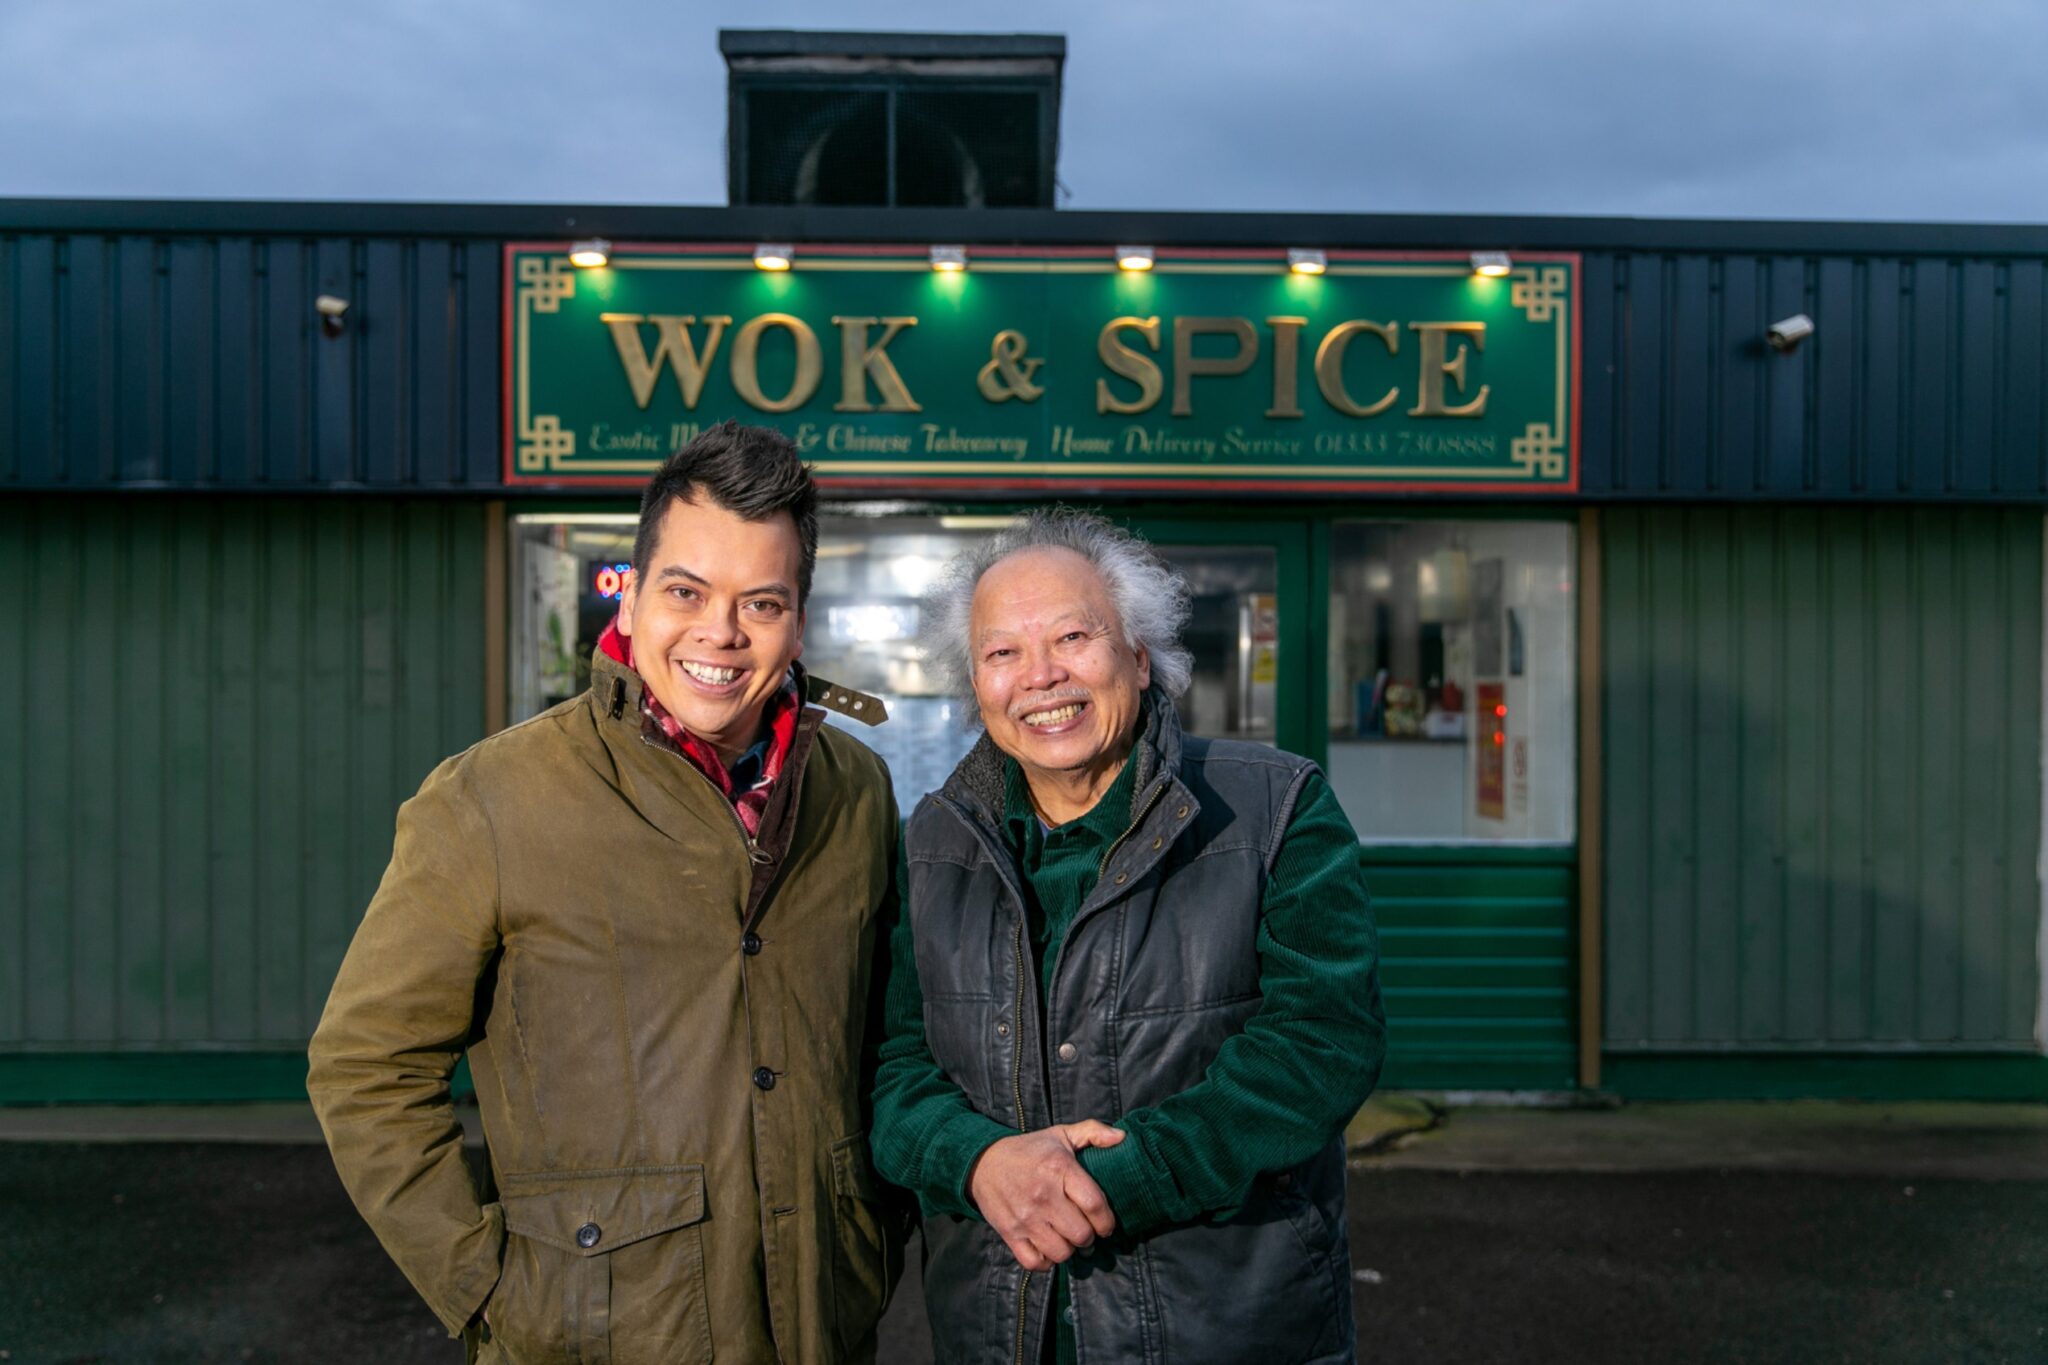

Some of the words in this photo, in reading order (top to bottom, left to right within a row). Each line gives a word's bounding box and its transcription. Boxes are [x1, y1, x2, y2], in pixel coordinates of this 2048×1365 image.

[600, 313, 920, 413] WOK
[977, 328, 1046, 403] &
[1095, 315, 1491, 419] SPICE
[589, 422, 660, 452] Exotic
[797, 423, 821, 452] &
[827, 425, 912, 455] Chinese
[921, 424, 1028, 462] Takeaway
[1051, 426, 1114, 457] Home
[1123, 426, 1216, 462] Delivery
[1223, 427, 1302, 457] Service
[1315, 430, 1388, 456] 01333
